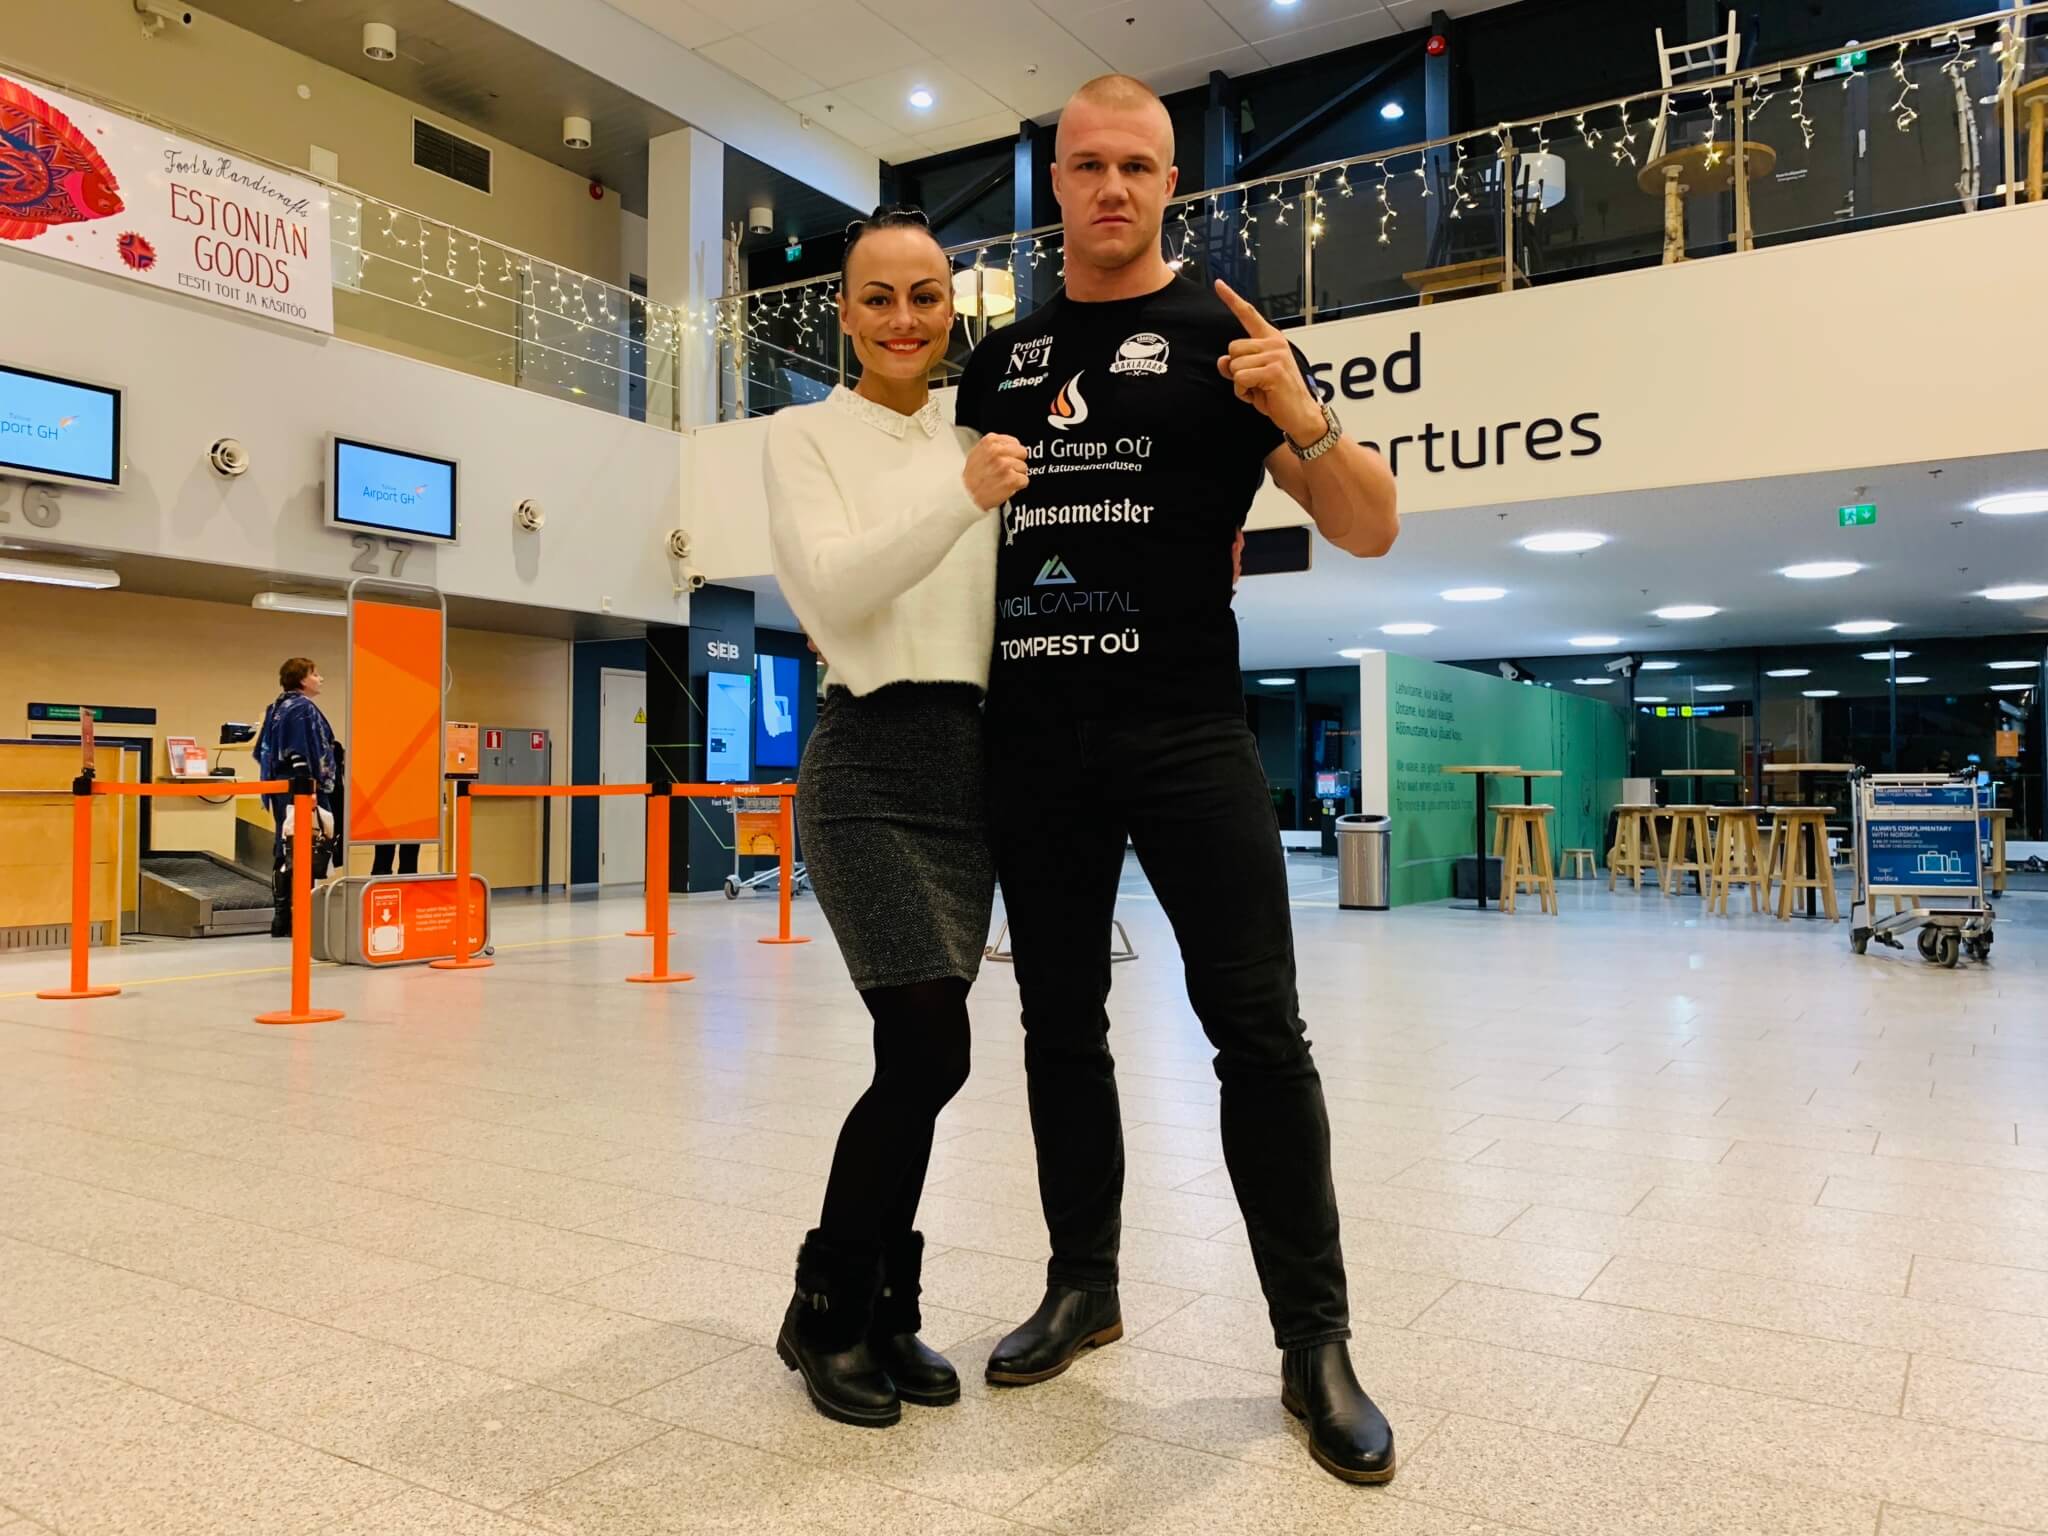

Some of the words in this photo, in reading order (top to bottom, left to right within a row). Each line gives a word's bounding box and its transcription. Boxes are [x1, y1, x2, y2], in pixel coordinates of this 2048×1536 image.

[164, 149, 201, 174] Food
[202, 159, 213, 176] &
[215, 157, 310, 217] Handicrafts
[170, 182, 309, 260] ESTONIAN
[194, 235, 290, 294] GOODS
[178, 272, 212, 293] EESTI
[215, 282, 241, 301] TOIT
[246, 291, 258, 305] JA
[1011, 335, 1054, 354] Protein
[37, 424, 58, 441] GH
[1050, 438, 1108, 460] Grupp
[1115, 435, 1153, 458] OÜ
[1357, 411, 1602, 478] rtures
[0, 484, 62, 528] 6
[362, 485, 398, 503] Airport
[400, 492, 415, 505] GH
[1013, 498, 1155, 534] Hansameister
[351, 536, 413, 578] 27
[1000, 595, 1037, 619] VIGIL
[1040, 591, 1141, 614] CAPITAL
[707, 640, 740, 660] SEB
[1001, 634, 1096, 660] TOMPEST
[1100, 627, 1140, 654] OÜ
